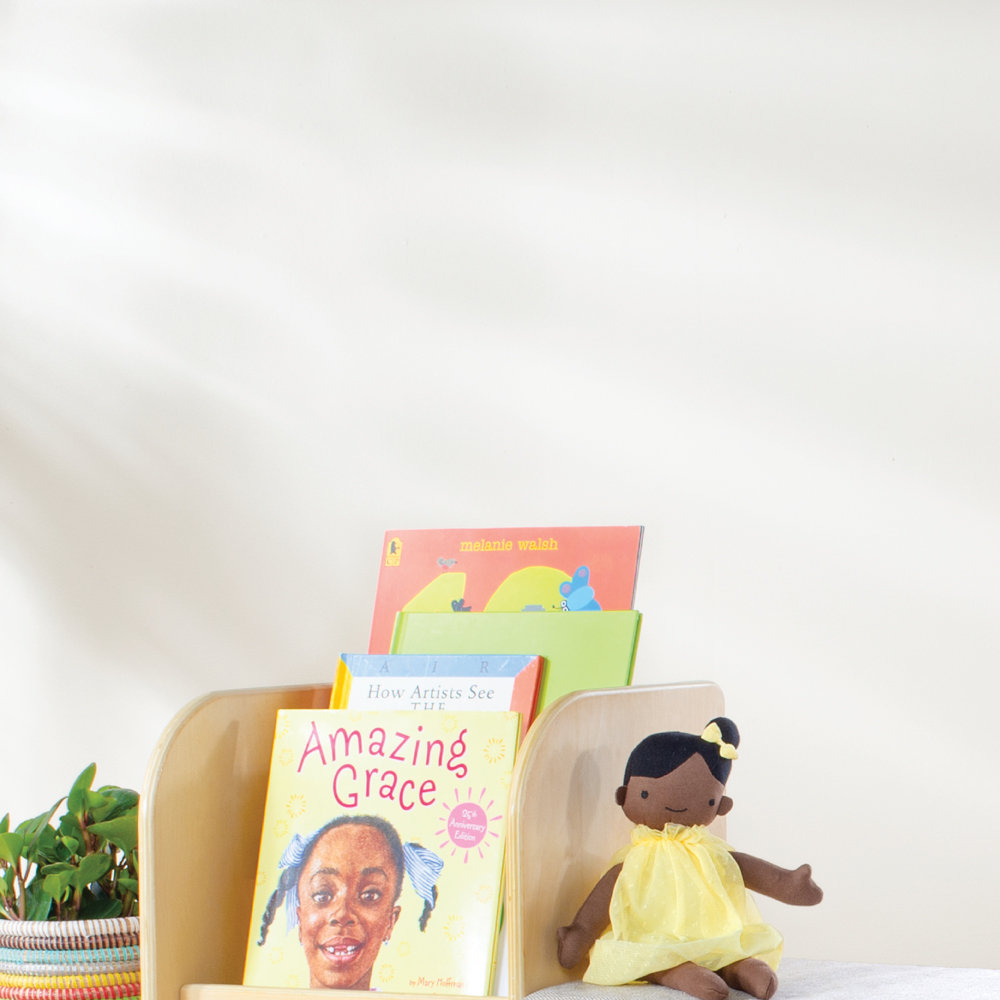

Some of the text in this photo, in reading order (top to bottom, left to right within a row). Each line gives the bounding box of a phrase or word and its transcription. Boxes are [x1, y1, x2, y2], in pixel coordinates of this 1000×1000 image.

[459, 537, 558, 552] melanie walsh
[368, 684, 495, 699] How Artists See
[297, 721, 469, 778] Amazing
[333, 764, 437, 810] Grace
[449, 818, 486, 833] Anniversary
[455, 830, 476, 841] Edition
